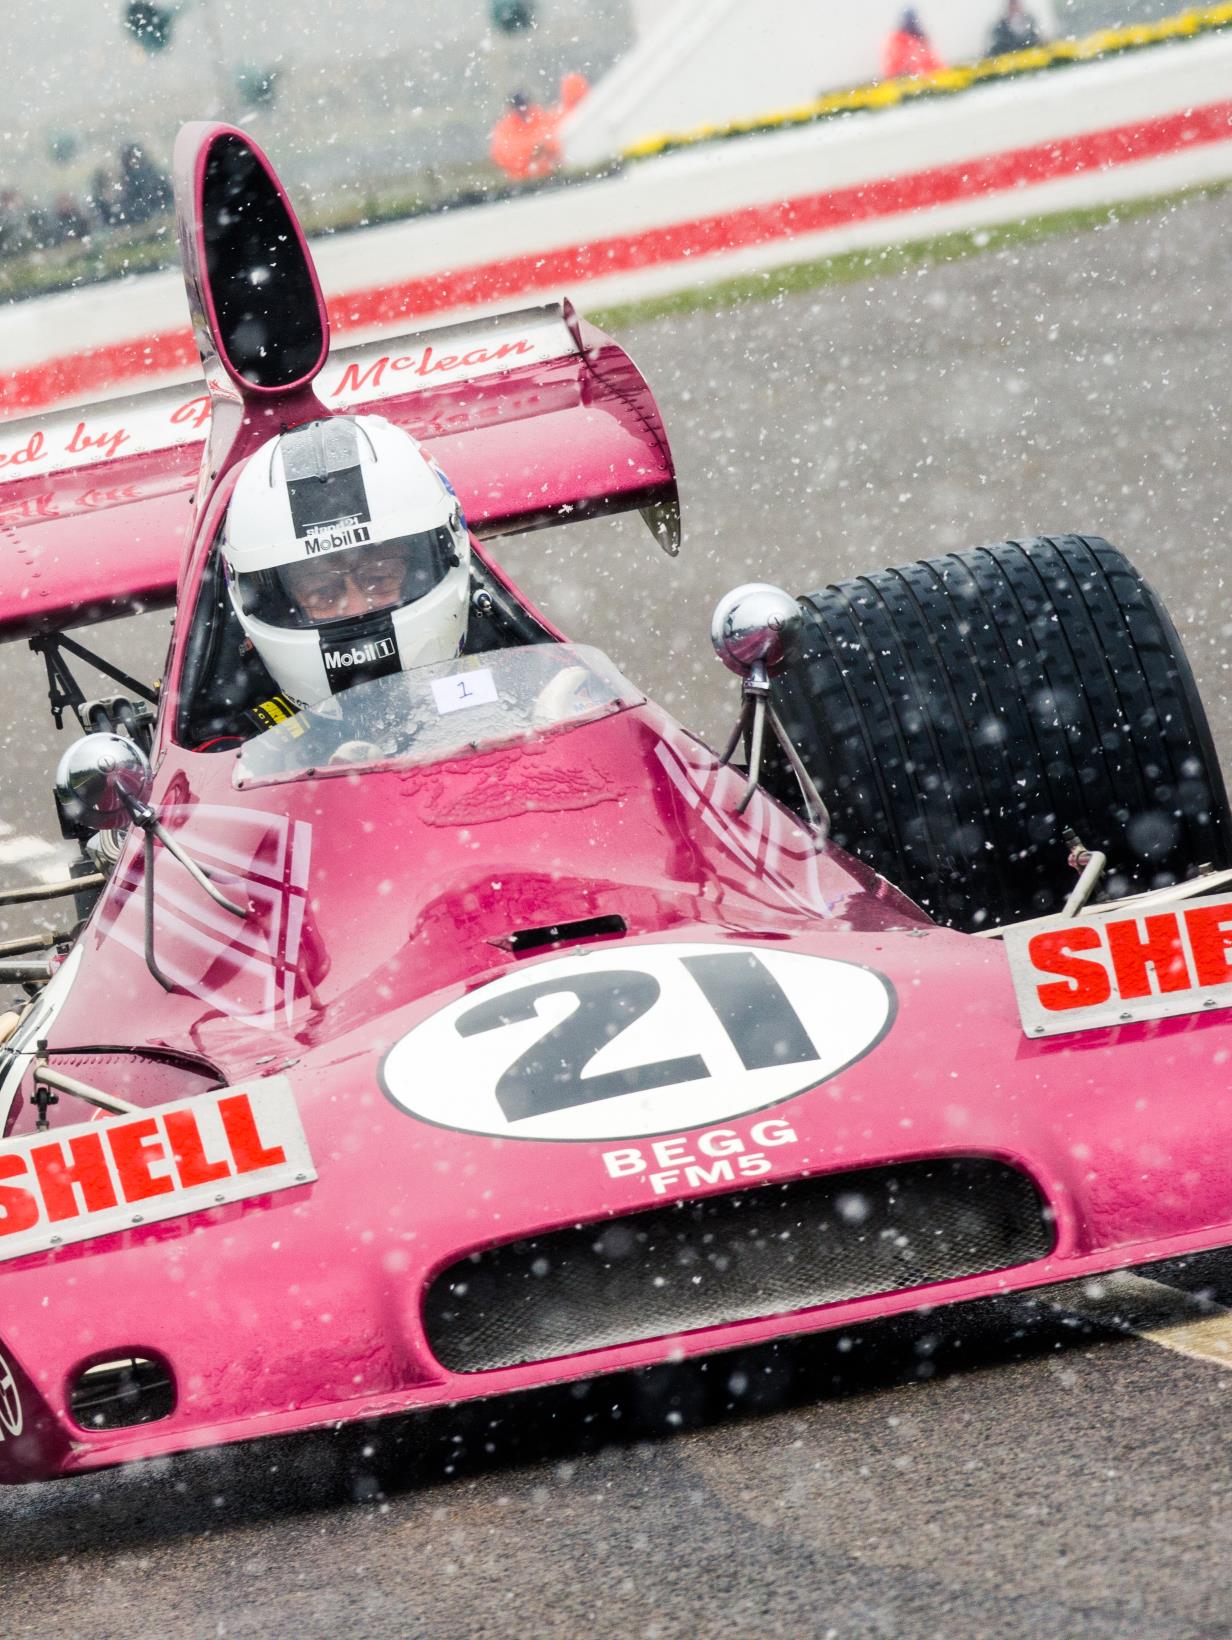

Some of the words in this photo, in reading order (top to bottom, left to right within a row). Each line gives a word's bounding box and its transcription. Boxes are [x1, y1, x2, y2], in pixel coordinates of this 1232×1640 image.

[331, 338, 534, 397] McLean
[64, 422, 130, 455] by
[305, 532, 353, 555] Mobil
[325, 645, 376, 669] Mobil
[457, 681, 473, 699] 1
[1028, 903, 1232, 1011] SHE
[455, 952, 821, 1122] 21
[602, 1120, 798, 1178] BEGG
[650, 1154, 772, 1194] FM5
